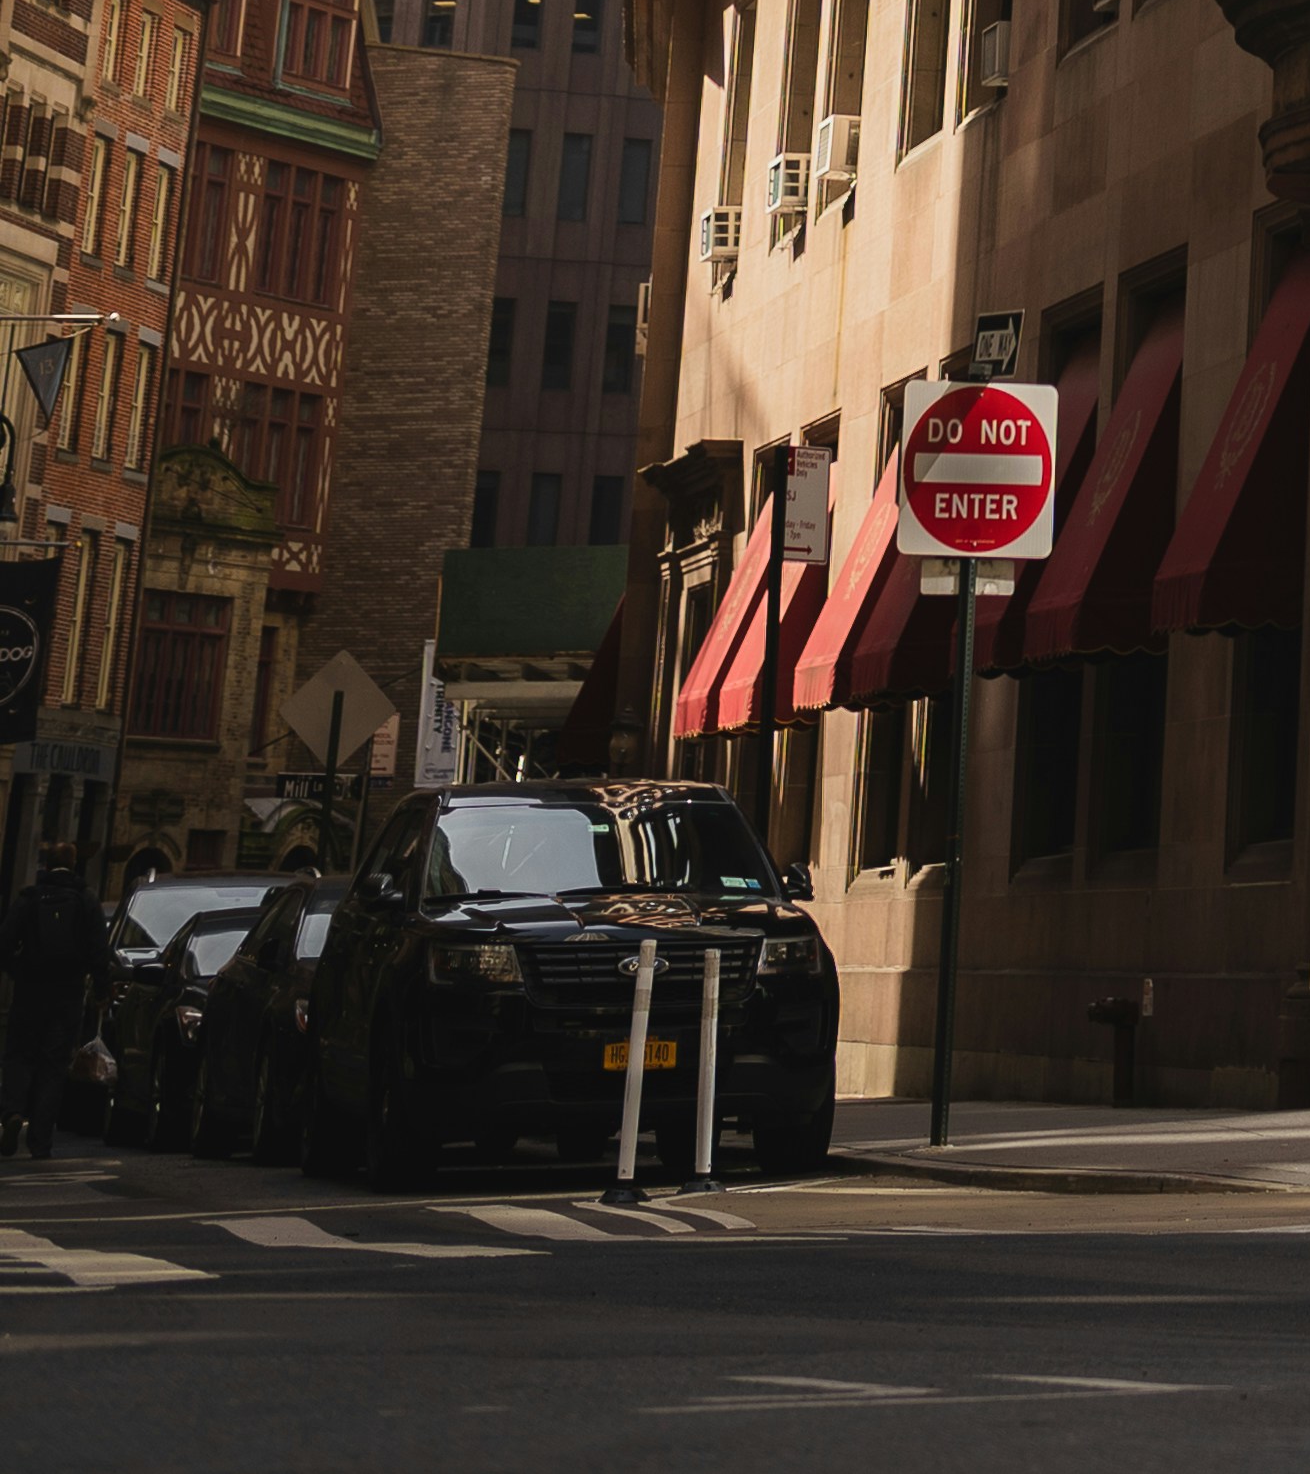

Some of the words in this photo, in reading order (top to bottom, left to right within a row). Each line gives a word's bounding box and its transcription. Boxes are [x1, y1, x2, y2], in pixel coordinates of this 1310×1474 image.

[979, 333, 994, 359] ONE
[997, 332, 1014, 357] WAY
[40, 359, 55, 376] 13
[928, 418, 963, 445] DO
[980, 419, 1032, 446] NOT
[796, 460, 818, 469] Vehicles
[797, 450, 826, 461] Authorized
[796, 469, 808, 478] Only
[934, 493, 1018, 520] ENTER
[799, 520, 816, 531] Friday
[433, 684, 444, 734] TRINITY
[441, 701, 454, 753] ANGONE
[31, 743, 48, 770] THE
[50, 744, 101, 776] CAULDRON
[284, 780, 309, 797] Mill
